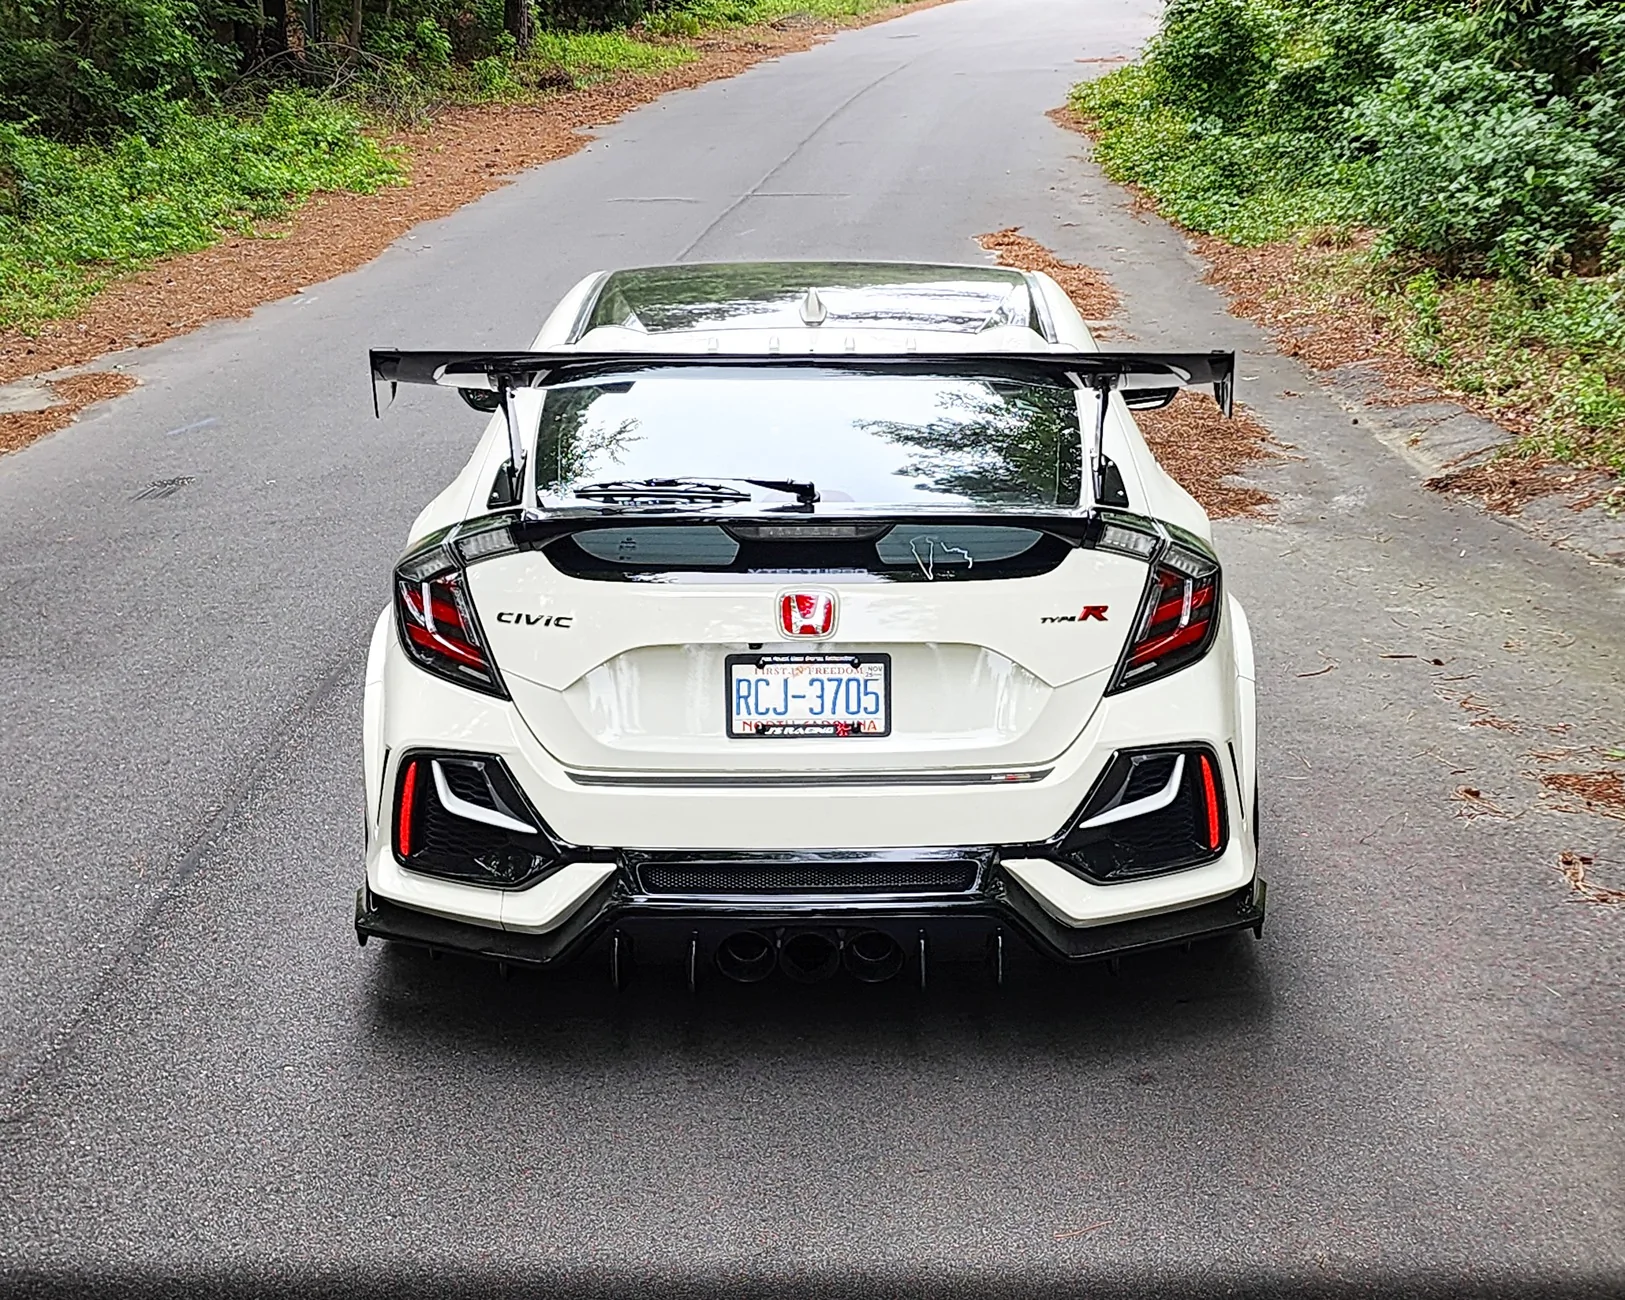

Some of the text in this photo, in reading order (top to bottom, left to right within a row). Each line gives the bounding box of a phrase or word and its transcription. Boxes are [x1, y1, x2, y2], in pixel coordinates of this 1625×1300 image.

[496, 612, 574, 628] CIVIC
[1077, 605, 1109, 622] R
[754, 666, 788, 675] FIRST
[807, 666, 865, 675] FREEDOM
[735, 677, 880, 715] RCJ-3705
